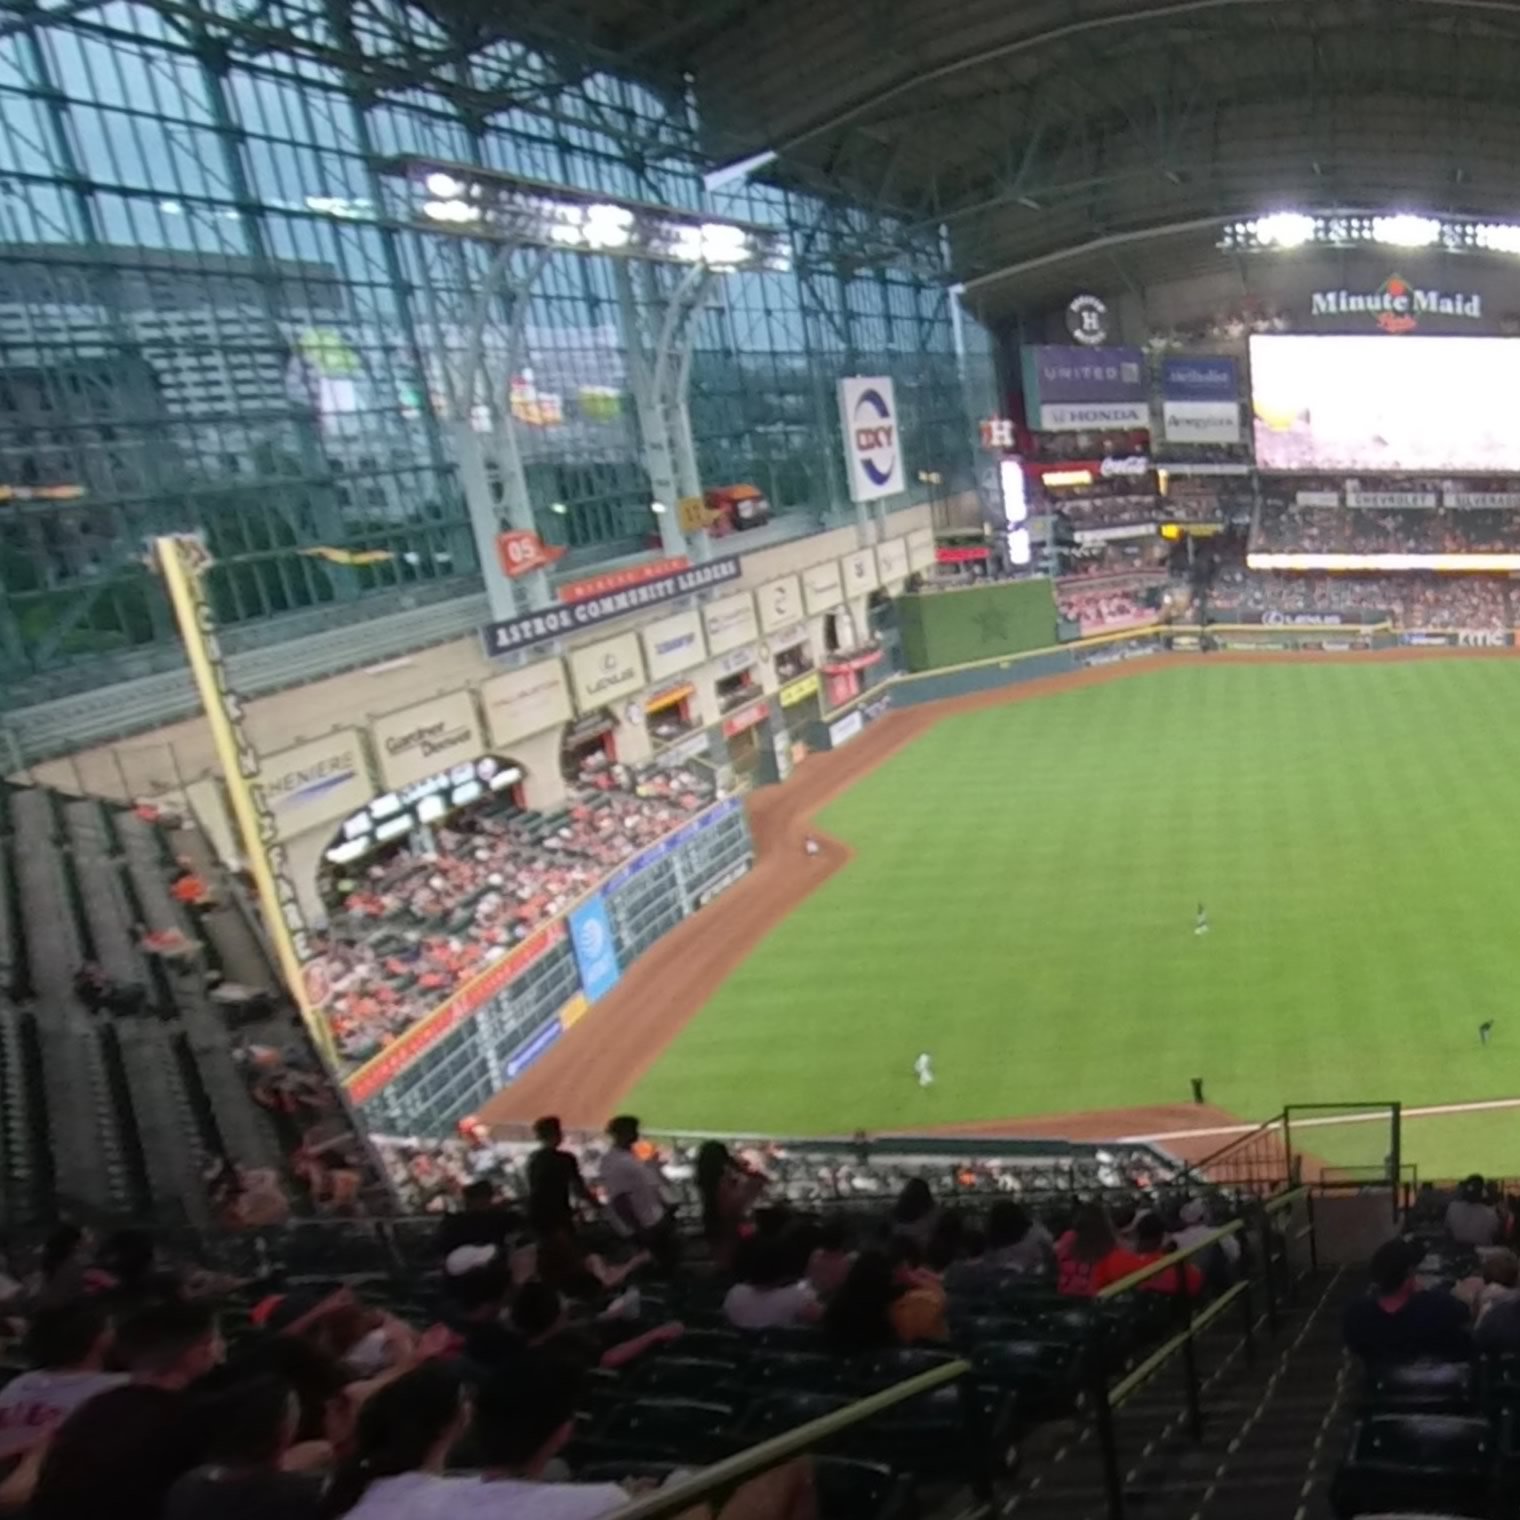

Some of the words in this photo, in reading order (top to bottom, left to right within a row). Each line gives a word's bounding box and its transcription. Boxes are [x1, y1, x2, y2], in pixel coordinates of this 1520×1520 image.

[1311, 290, 1408, 316] Minute
[1412, 289, 1482, 319] Maid
[1043, 366, 1117, 380] UNITED
[1069, 408, 1139, 422] HONDA
[496, 610, 572, 647] ASTROS
[574, 577, 678, 623] COMMUNITY
[678, 560, 736, 591] LEADERS
[585, 667, 636, 698] LEXUS
[264, 752, 354, 794] HENIERE
